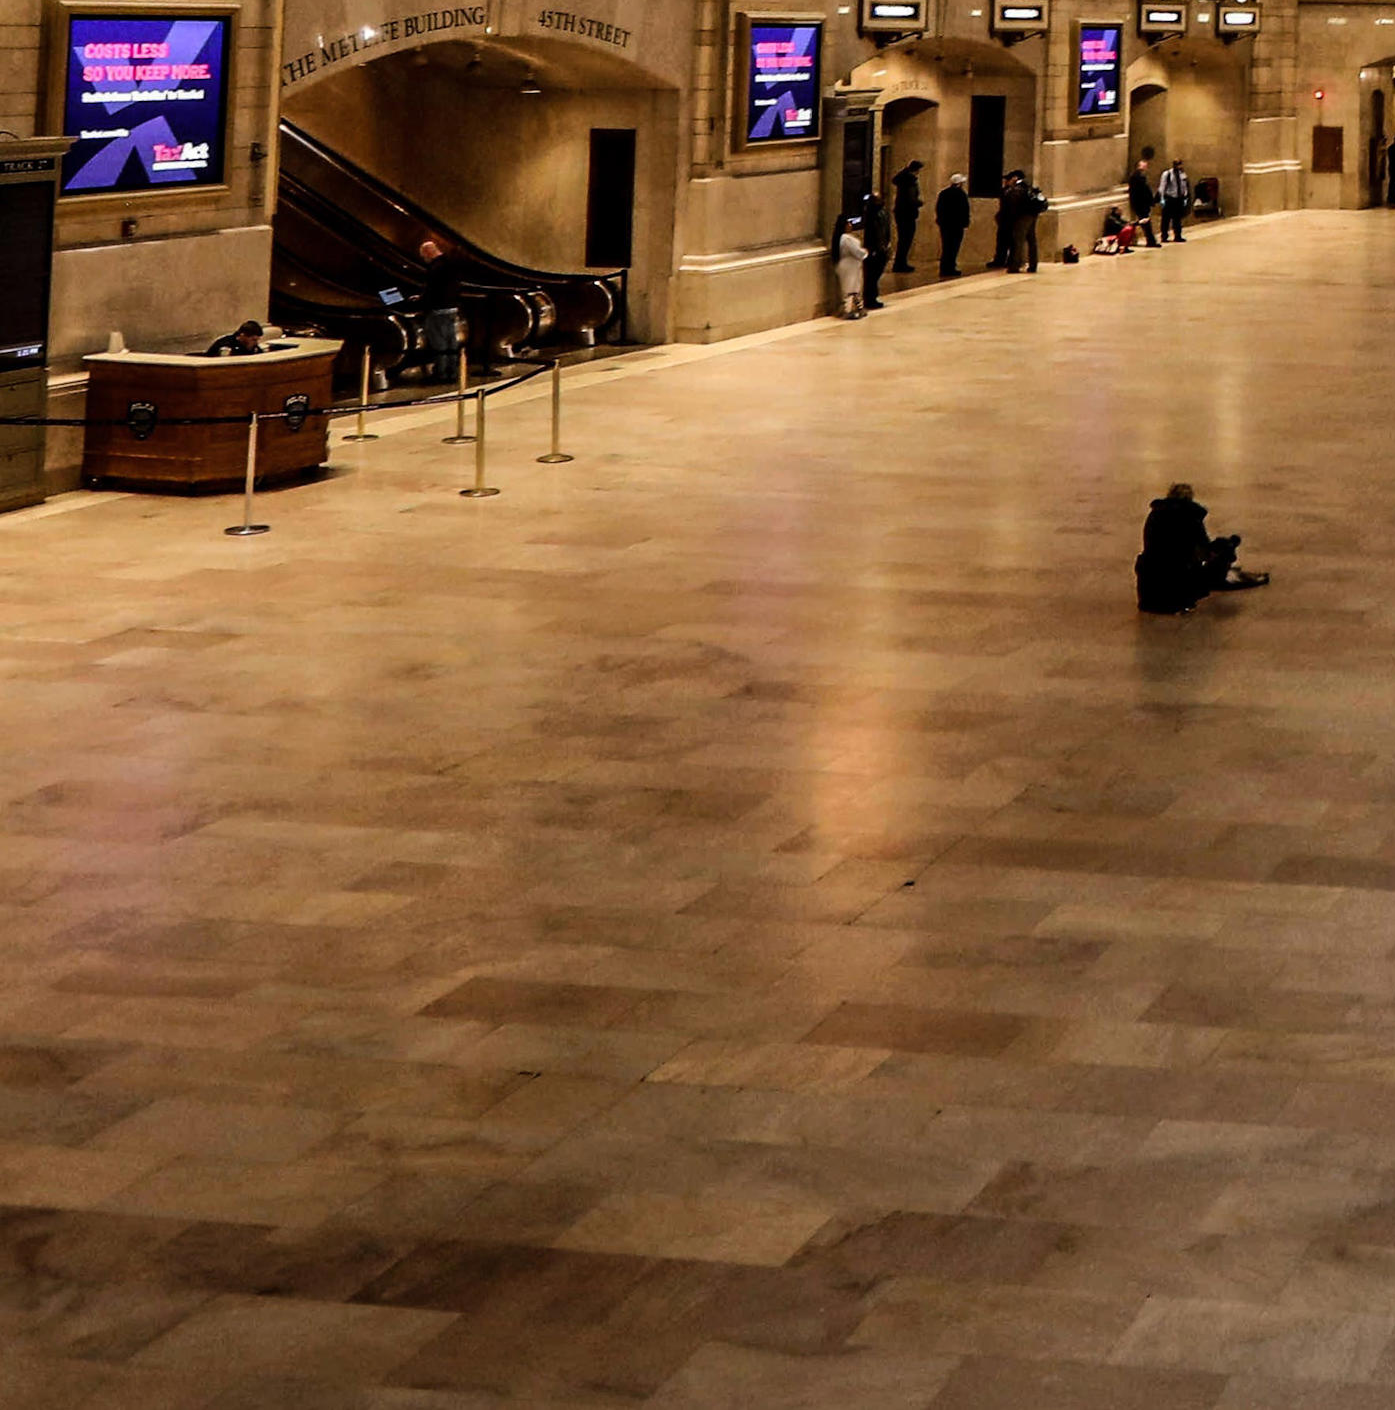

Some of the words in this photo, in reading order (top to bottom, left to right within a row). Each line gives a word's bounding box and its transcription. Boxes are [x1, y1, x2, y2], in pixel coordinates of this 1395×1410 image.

[404, 6, 485, 38] BUILDING
[538, 10, 576, 32] 45TH
[579, 17, 631, 48] STREET
[84, 42, 131, 59] COSTS
[132, 42, 169, 59] LESS
[83, 65, 104, 82] SO
[105, 65, 134, 81] YOU
[135, 64, 171, 81] KEEP
[153, 142, 209, 161] TaxAct
